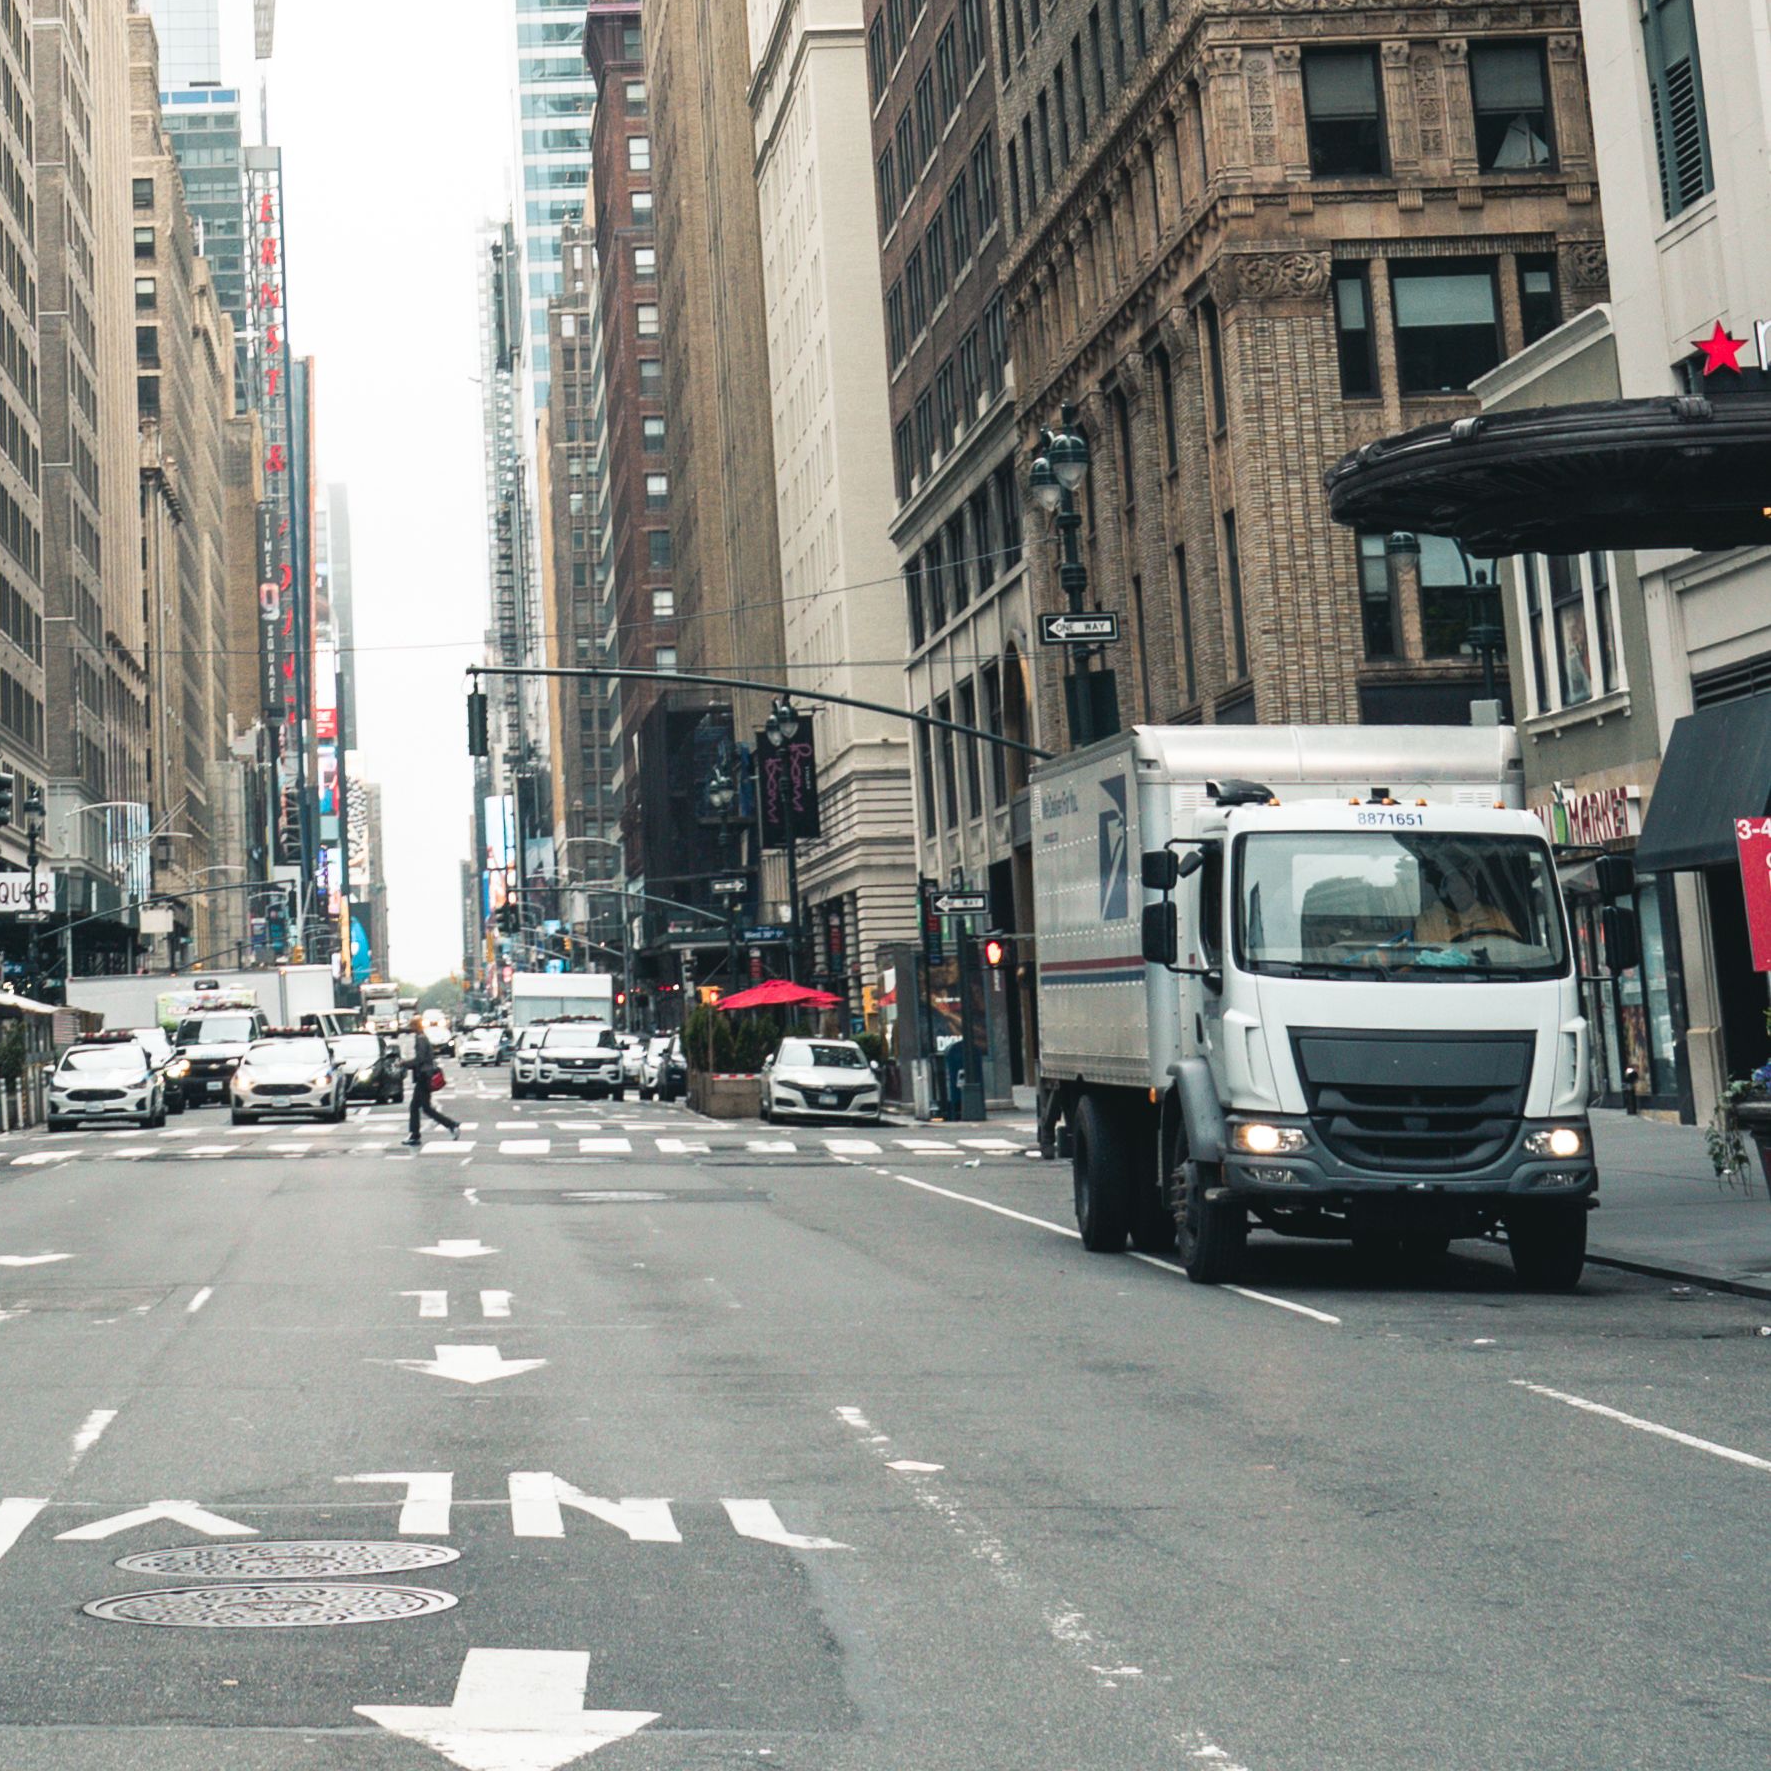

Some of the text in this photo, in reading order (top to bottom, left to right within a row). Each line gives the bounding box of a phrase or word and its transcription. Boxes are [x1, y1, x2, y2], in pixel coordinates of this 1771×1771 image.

[1056, 622, 1106, 633] ONE WAY
[266, 624, 277, 704] SQUARE
[1357, 812, 1424, 826] 8871651
[1568, 785, 1630, 845] MARKET
